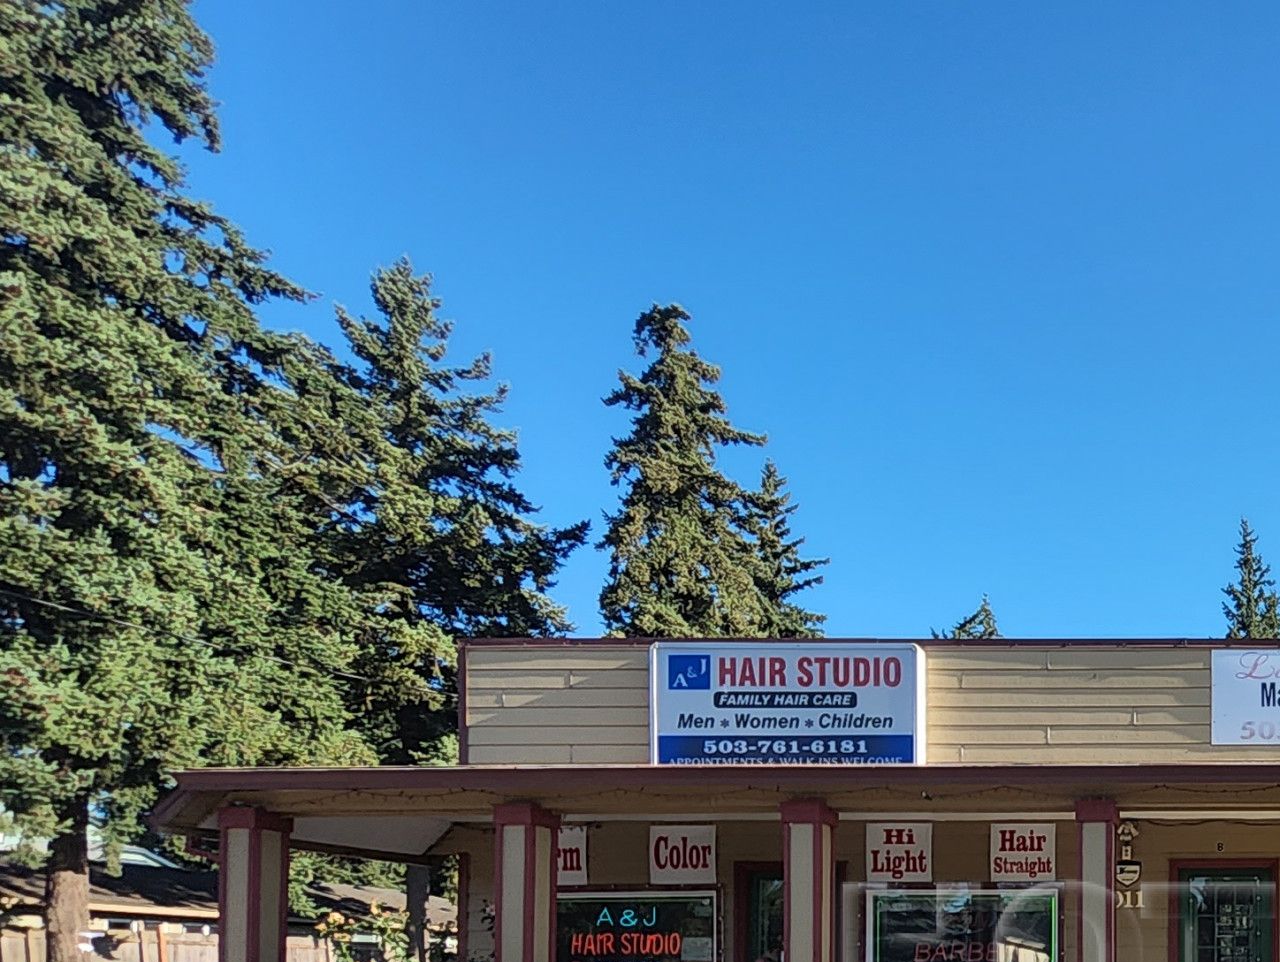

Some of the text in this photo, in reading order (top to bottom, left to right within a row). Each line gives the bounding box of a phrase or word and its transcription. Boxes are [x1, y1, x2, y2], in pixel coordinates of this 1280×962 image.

[673, 658, 707, 688] A & J
[718, 656, 902, 688] HAIR STUDIO
[718, 694, 853, 706] FAMILY HAIR CARE
[677, 712, 894, 729] Men Women Children
[703, 739, 869, 755] 503-761-6181
[883, 828, 916, 845] Hi
[999, 829, 1047, 853] Hair
[653, 835, 712, 870] Color
[870, 850, 928, 879] Light
[993, 857, 1053, 878] Straight
[596, 906, 657, 927] A & J
[570, 933, 616, 956] HAIR
[620, 931, 682, 956] STUDIO
[913, 941, 1000, 962] BARBE
